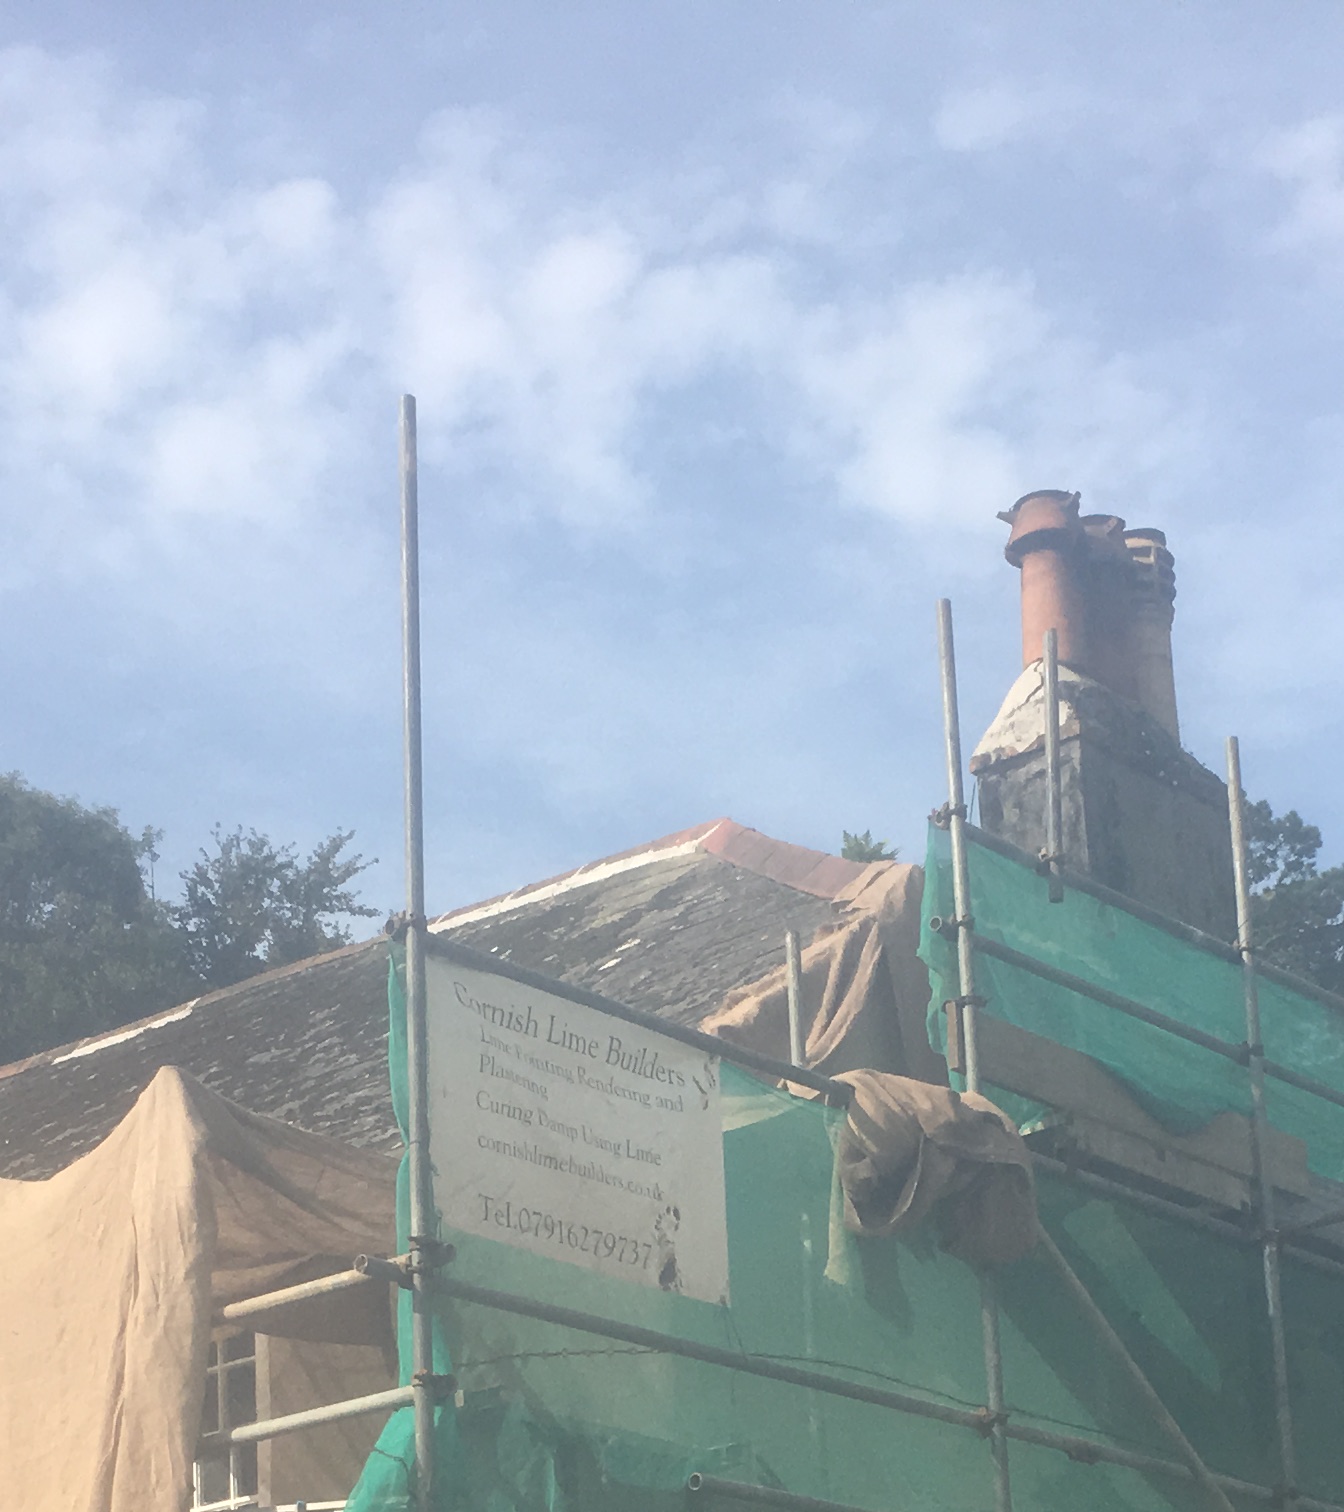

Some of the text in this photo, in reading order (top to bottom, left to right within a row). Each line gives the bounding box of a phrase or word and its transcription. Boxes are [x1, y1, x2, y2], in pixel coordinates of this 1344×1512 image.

[453, 981, 685, 1087] Cornish Lime Builders
[577, 1066, 651, 1109] Rendering
[655, 1094, 684, 1112] and
[476, 1090, 661, 1166] Curing Damp Using Lime
